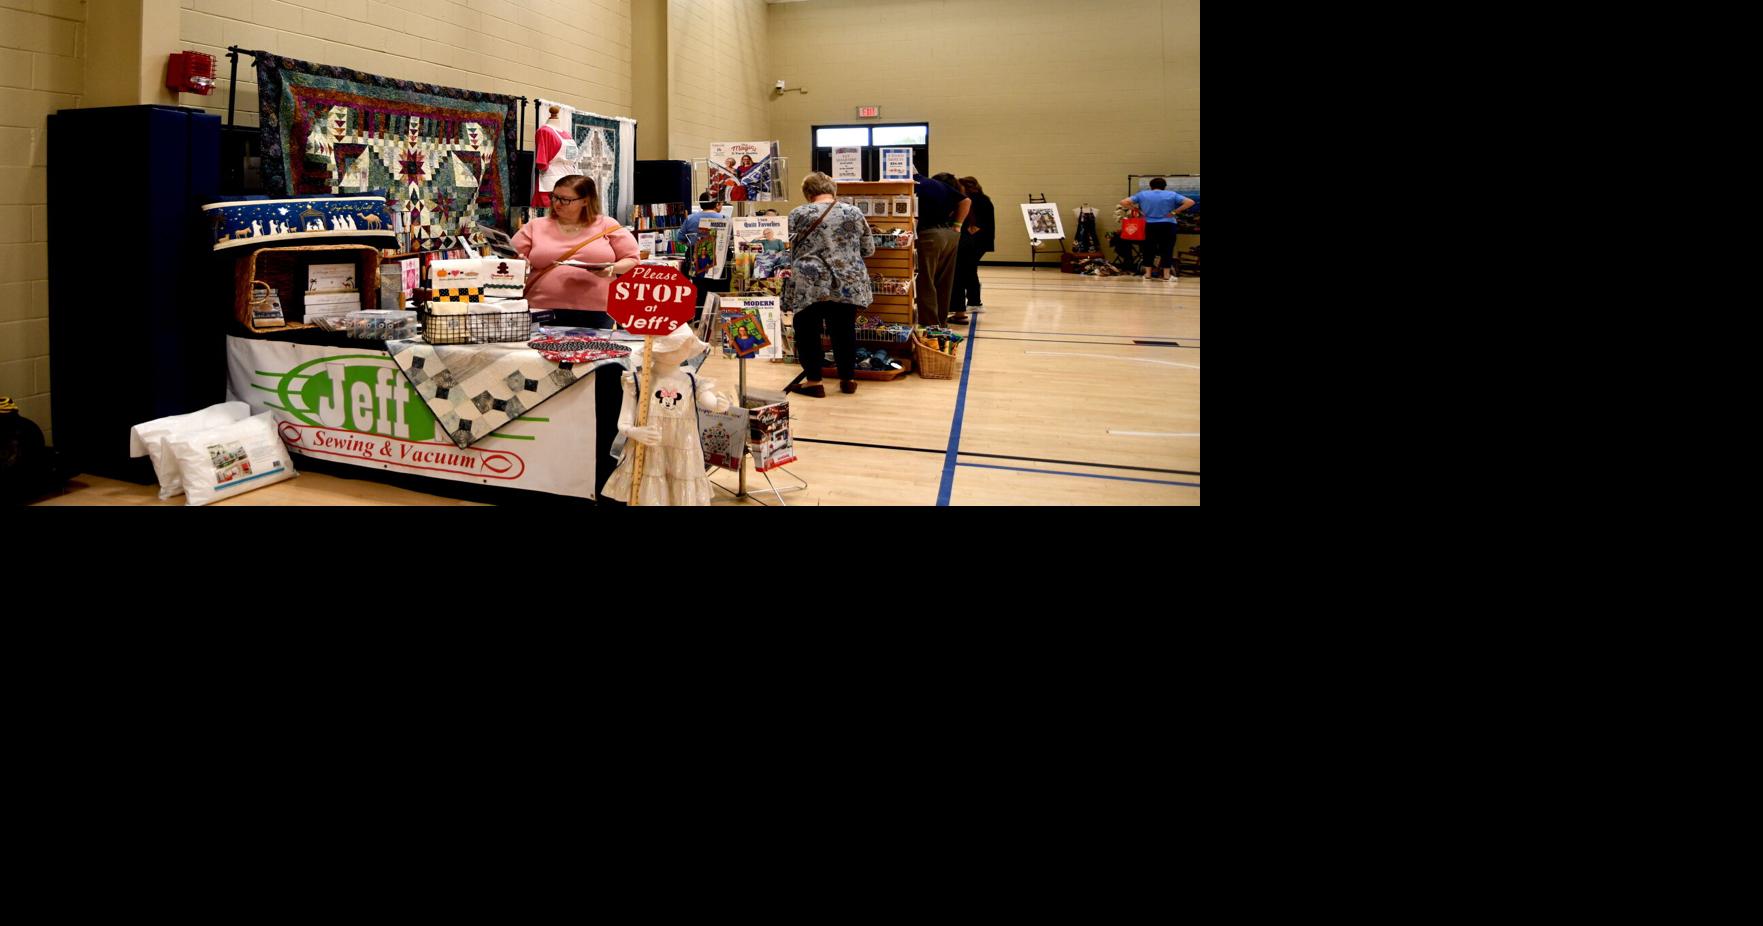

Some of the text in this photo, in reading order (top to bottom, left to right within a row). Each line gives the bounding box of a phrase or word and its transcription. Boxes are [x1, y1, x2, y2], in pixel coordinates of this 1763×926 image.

[632, 267, 677, 280] Please
[615, 282, 691, 303] STOP
[621, 314, 678, 331] Jeff's
[319, 363, 450, 443] Jeff
[313, 431, 476, 469] Sewing & Vacuum
